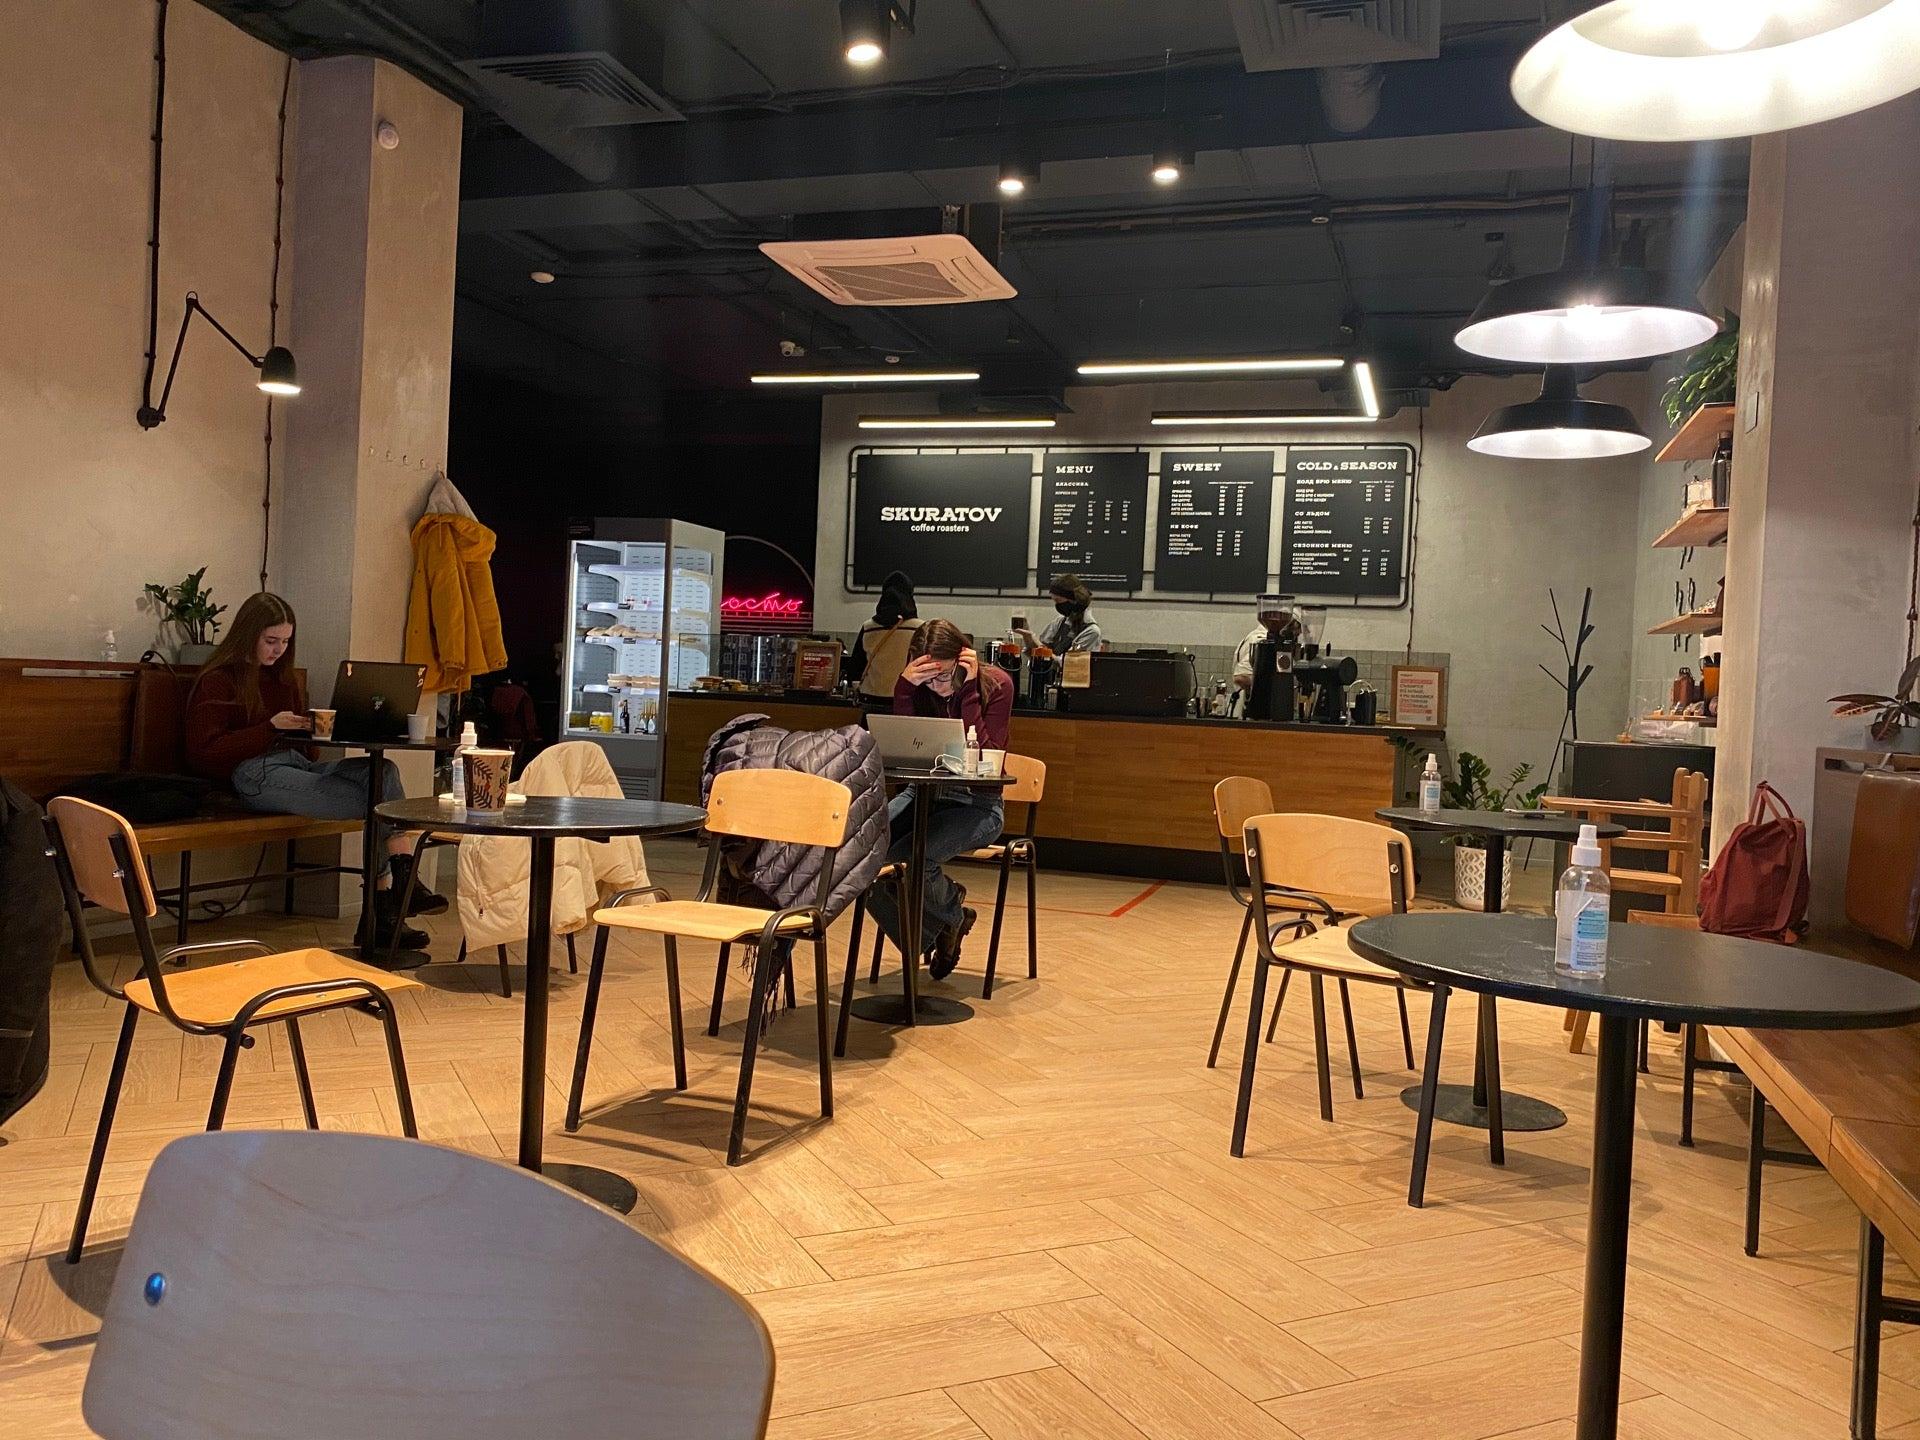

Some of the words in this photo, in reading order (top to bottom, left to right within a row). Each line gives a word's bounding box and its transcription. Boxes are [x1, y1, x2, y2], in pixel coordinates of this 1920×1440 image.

[1055, 465, 1094, 474] MENU
[1173, 463, 1222, 472] SWEET
[1296, 461, 1334, 471] COLD
[1340, 461, 1398, 471] SEASON
[881, 506, 1003, 522] SKURATOV
[910, 523, 936, 532] coffee
[936, 524, 970, 532] roasters
[912, 737, 924, 751] hp
